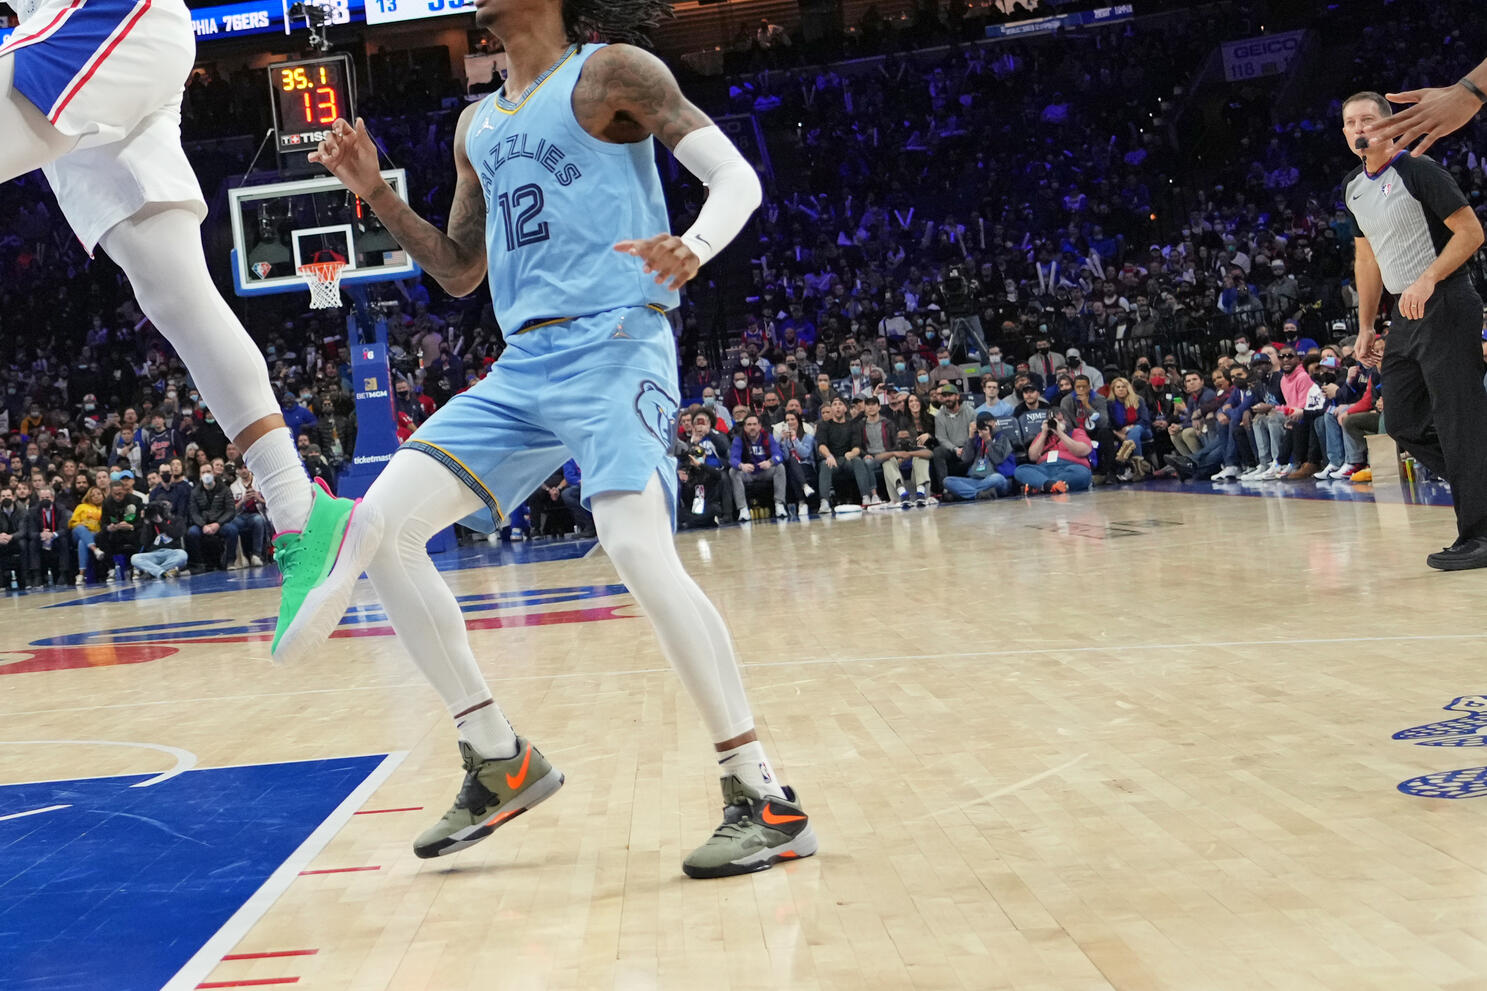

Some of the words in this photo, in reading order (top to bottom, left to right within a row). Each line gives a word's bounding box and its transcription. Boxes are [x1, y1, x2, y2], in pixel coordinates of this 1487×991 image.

[222, 11, 269, 32] 76ERS
[1234, 38, 1297, 59] GEICO
[281, 67, 327, 91] 35.1
[304, 87, 338, 124] 13
[485, 132, 582, 215] RIZZLIES
[498, 183, 550, 252] 12
[356, 390, 388, 400] BETMGM
